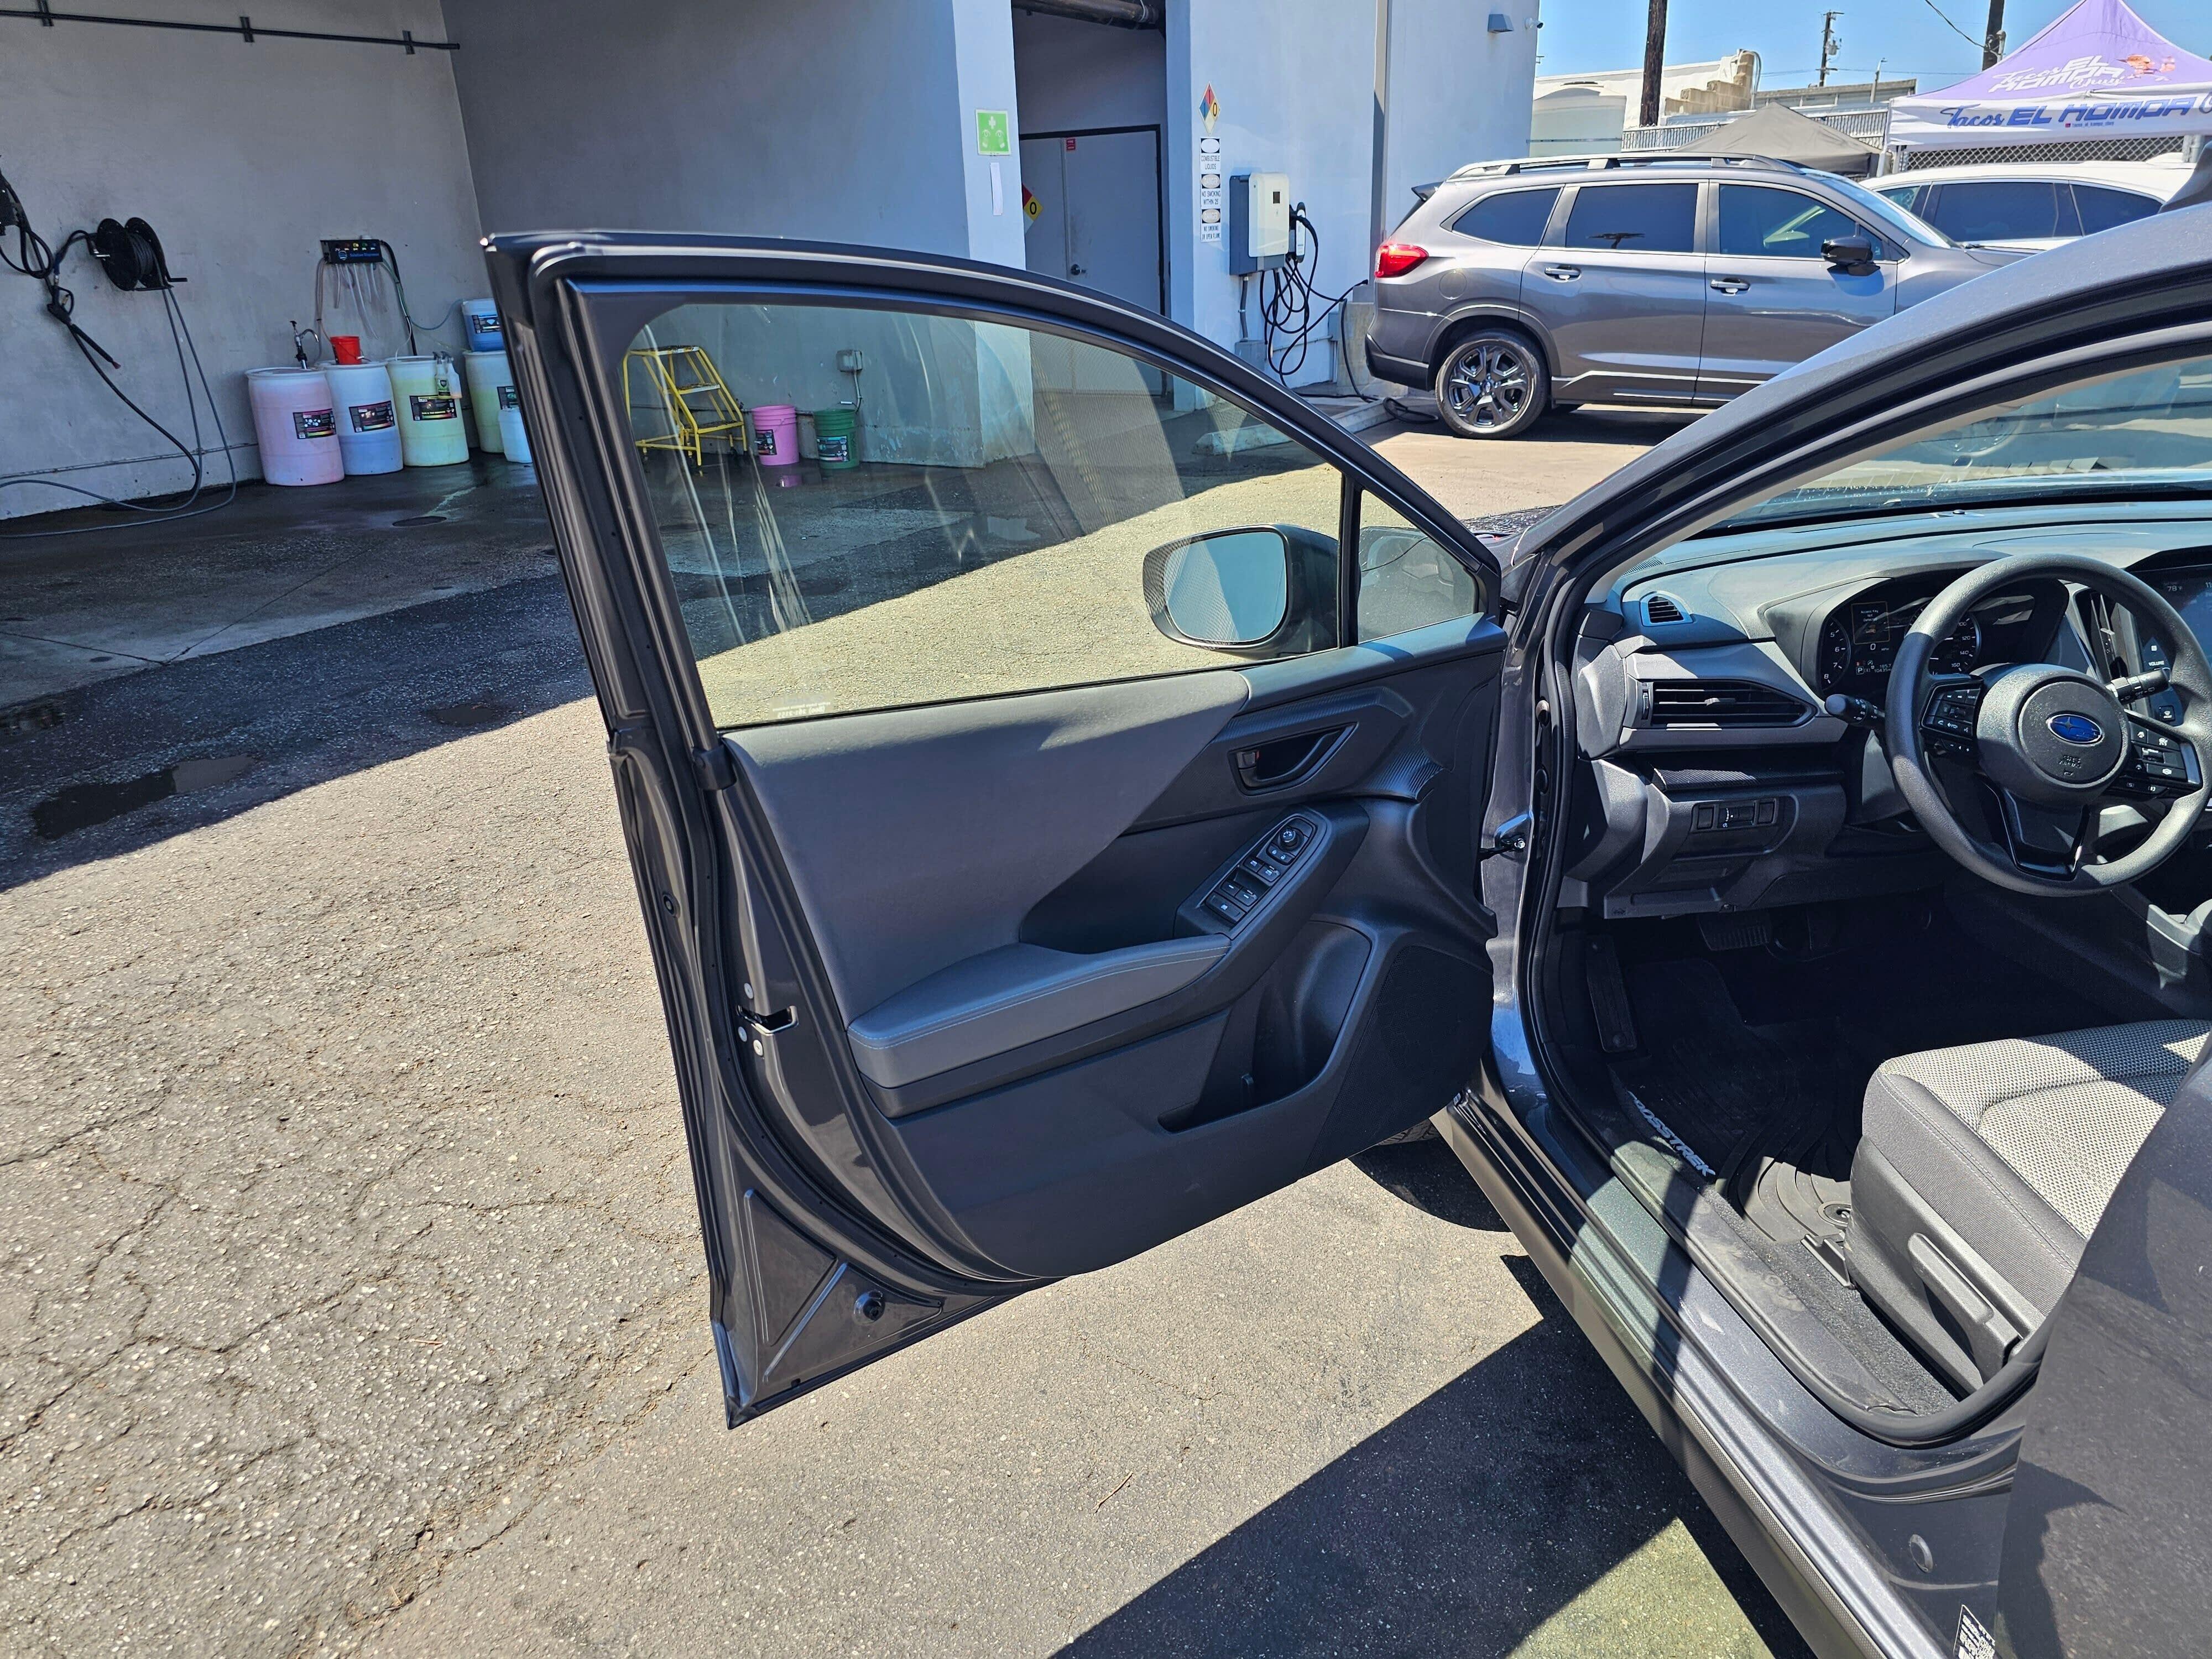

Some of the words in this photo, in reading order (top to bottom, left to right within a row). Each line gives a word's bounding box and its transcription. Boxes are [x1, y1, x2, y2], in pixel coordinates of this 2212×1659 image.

[2061, 55, 2109, 72] EL
[1213, 102, 1218, 117] 0
[1940, 103, 2005, 128] Tacos
[2007, 105, 2052, 126] EL
[1029, 201, 1037, 215] 0
